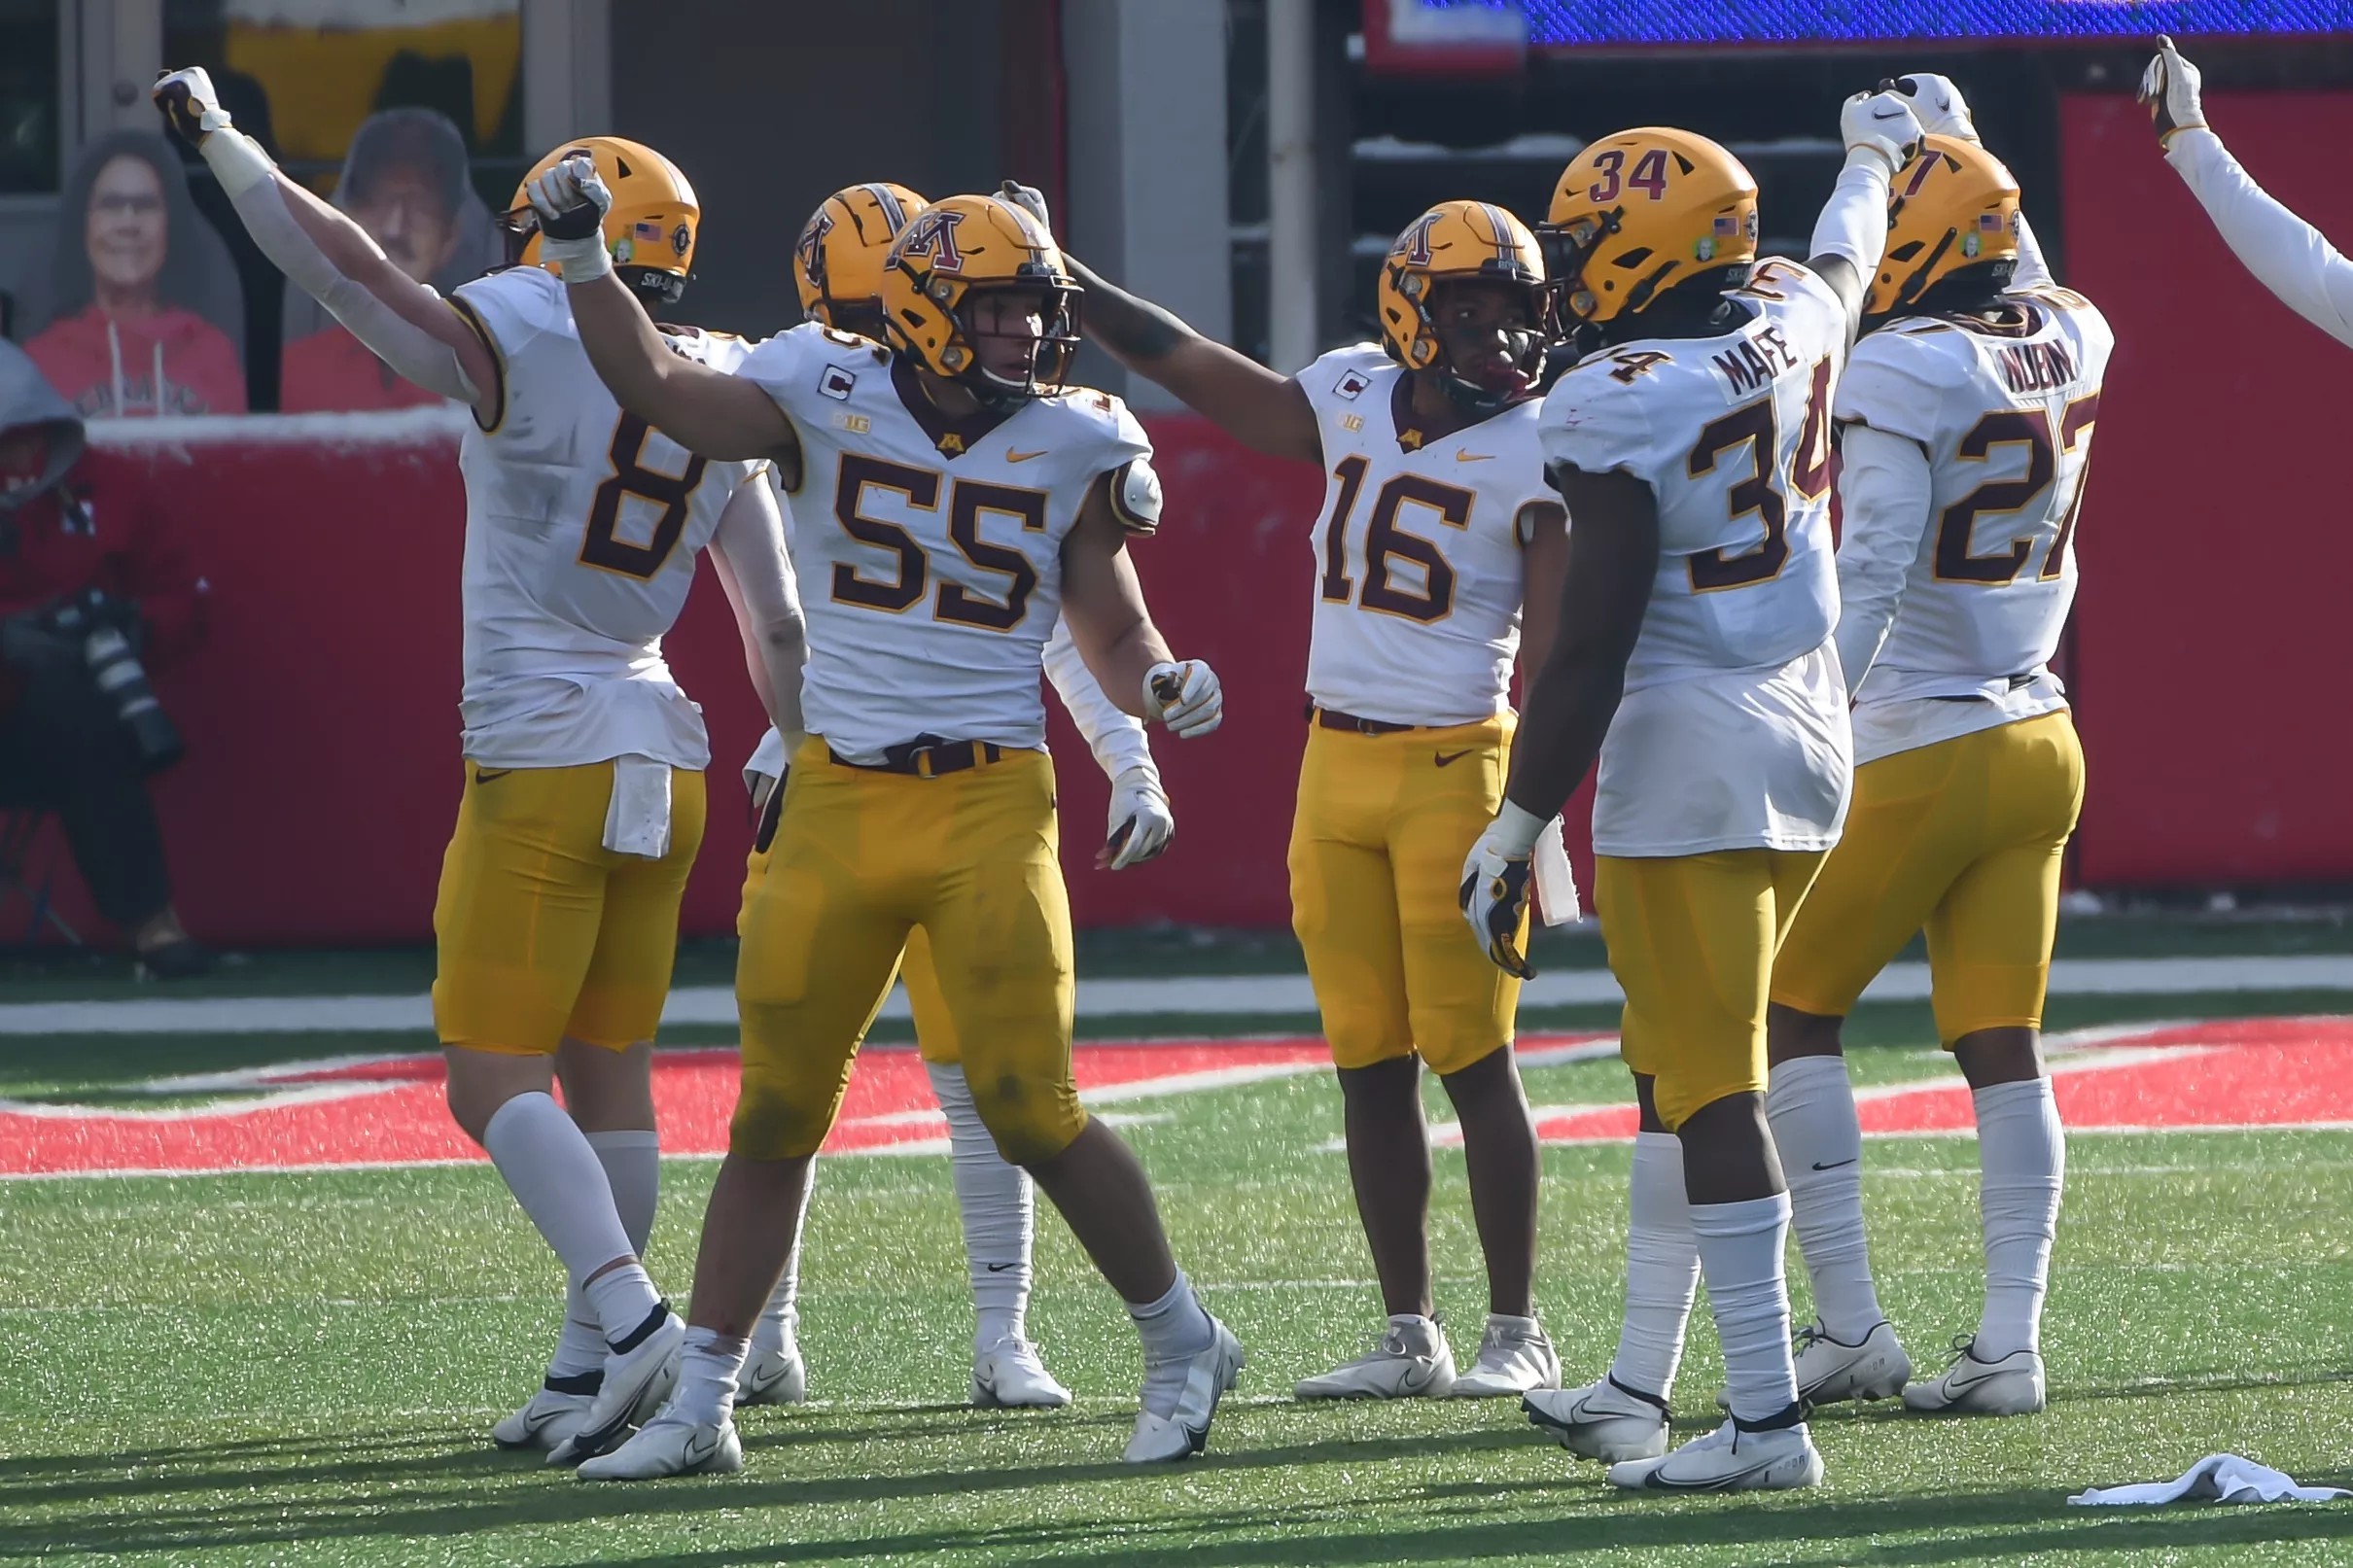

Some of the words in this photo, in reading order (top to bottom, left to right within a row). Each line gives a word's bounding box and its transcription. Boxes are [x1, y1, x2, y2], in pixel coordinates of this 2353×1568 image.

[1589, 149, 1668, 203] 34
[817, 363, 858, 401] C
[1333, 369, 1372, 401] C
[1711, 326, 1797, 397] MAFE
[1998, 339, 2078, 393] NUBIN
[576, 408, 708, 583] 8
[1685, 351, 1833, 597] 34
[1932, 391, 2102, 587] 27
[829, 449, 1051, 635] 55
[1320, 452, 1478, 627] 16
